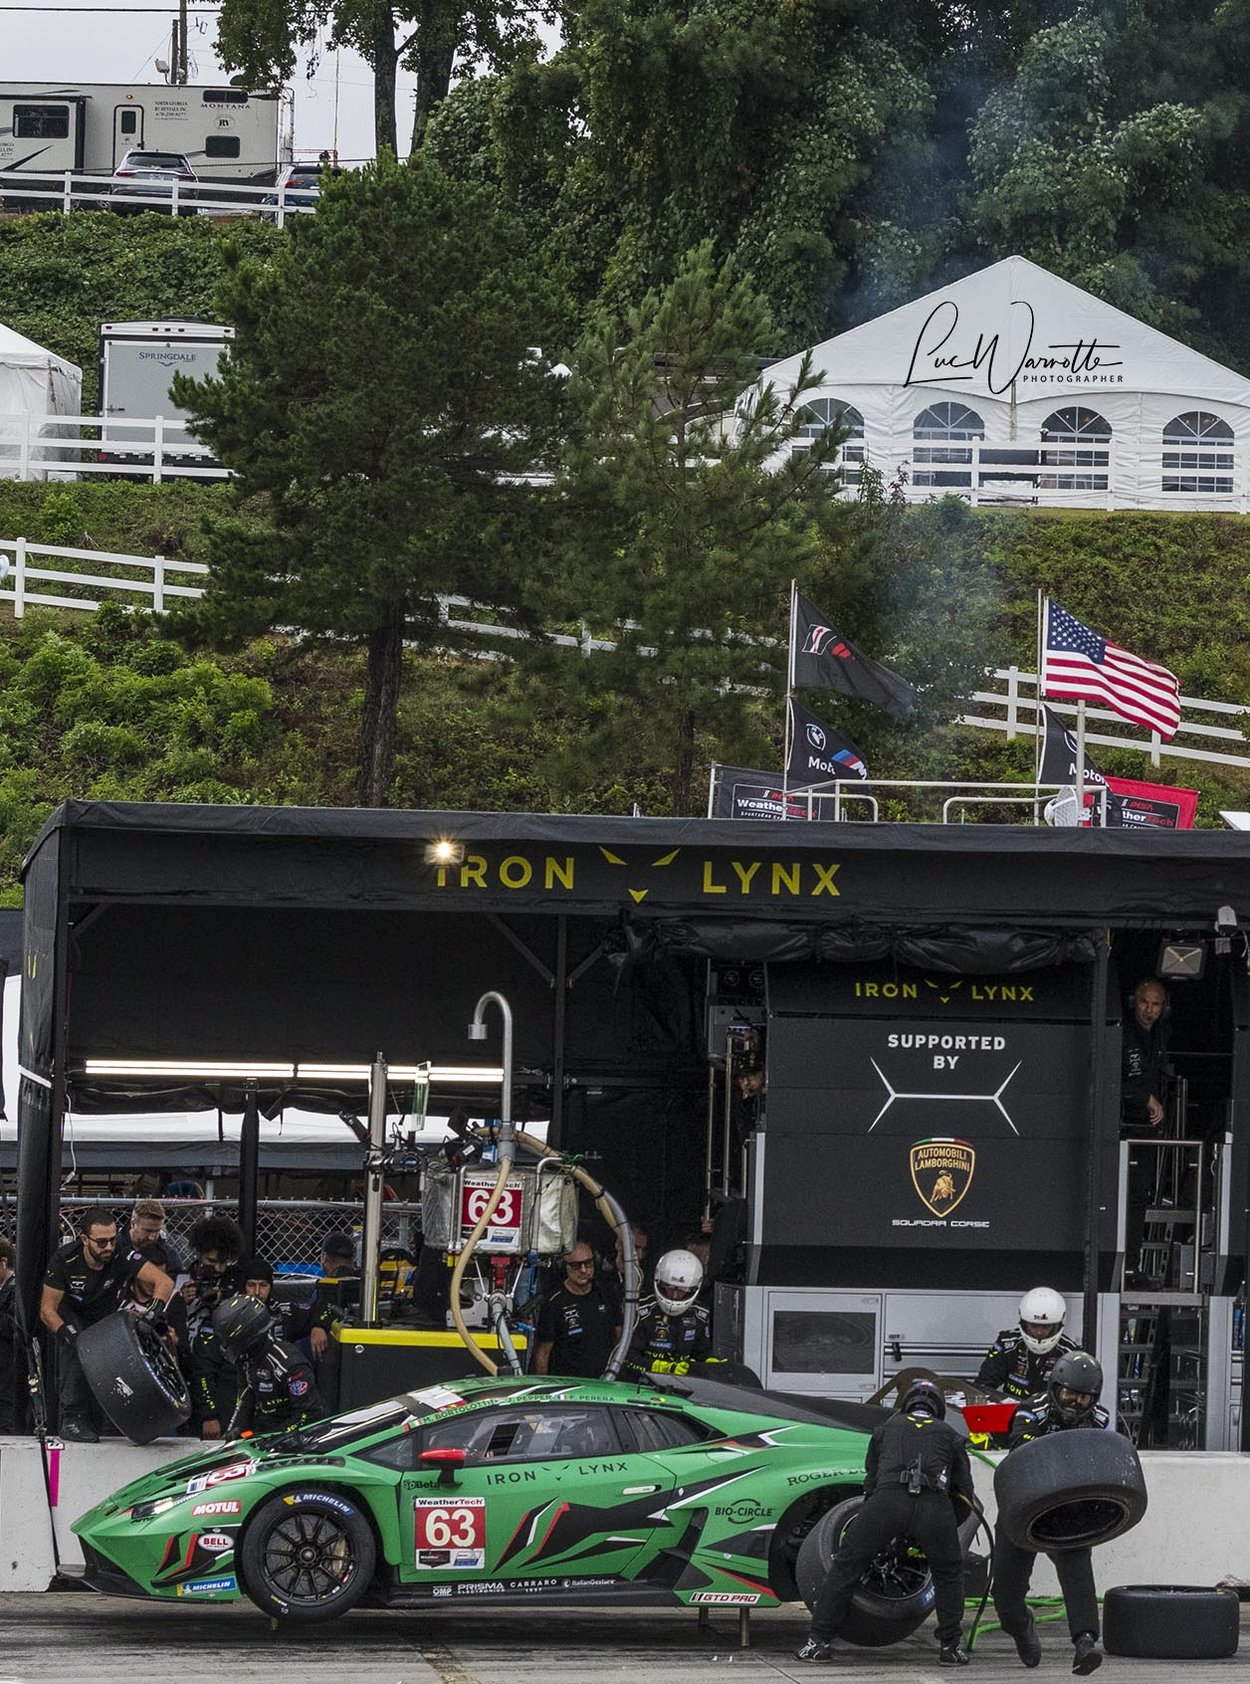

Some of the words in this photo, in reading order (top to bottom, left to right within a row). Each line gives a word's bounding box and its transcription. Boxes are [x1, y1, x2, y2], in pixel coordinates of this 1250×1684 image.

[139, 352, 196, 360] SPRINGDALE
[437, 857, 574, 890] IRON
[703, 862, 841, 896] LYNX
[855, 983, 917, 999] IRON
[972, 986, 1034, 1001] LYNX
[888, 1034, 1006, 1050] SUPPORTED
[933, 1056, 960, 1070] BY
[917, 1147, 967, 1161] AUTOMOBILI
[914, 1158, 970, 1173] LAMBORGHINI
[468, 1189, 513, 1225] 63
[892, 1219, 947, 1227] SQUADRA
[951, 1220, 990, 1228] CORSE
[487, 1470, 536, 1486] IRON
[578, 1461, 629, 1476] LYNX
[786, 1469, 844, 1487] ROGER
[193, 1501, 239, 1516] MOTUL
[302, 1493, 350, 1513] MICHELIN
[715, 1507, 773, 1517] BIO-CIRCLE
[425, 1508, 476, 1548] 63
[203, 1537, 229, 1546] BELL
[192, 1581, 231, 1591] MICHELIN
[457, 1582, 504, 1591] PRISMA
[510, 1578, 558, 1588] CARRARO
[433, 1587, 452, 1596] OMP
[702, 1594, 729, 1602] GTD
[730, 1594, 757, 1602] PRO
